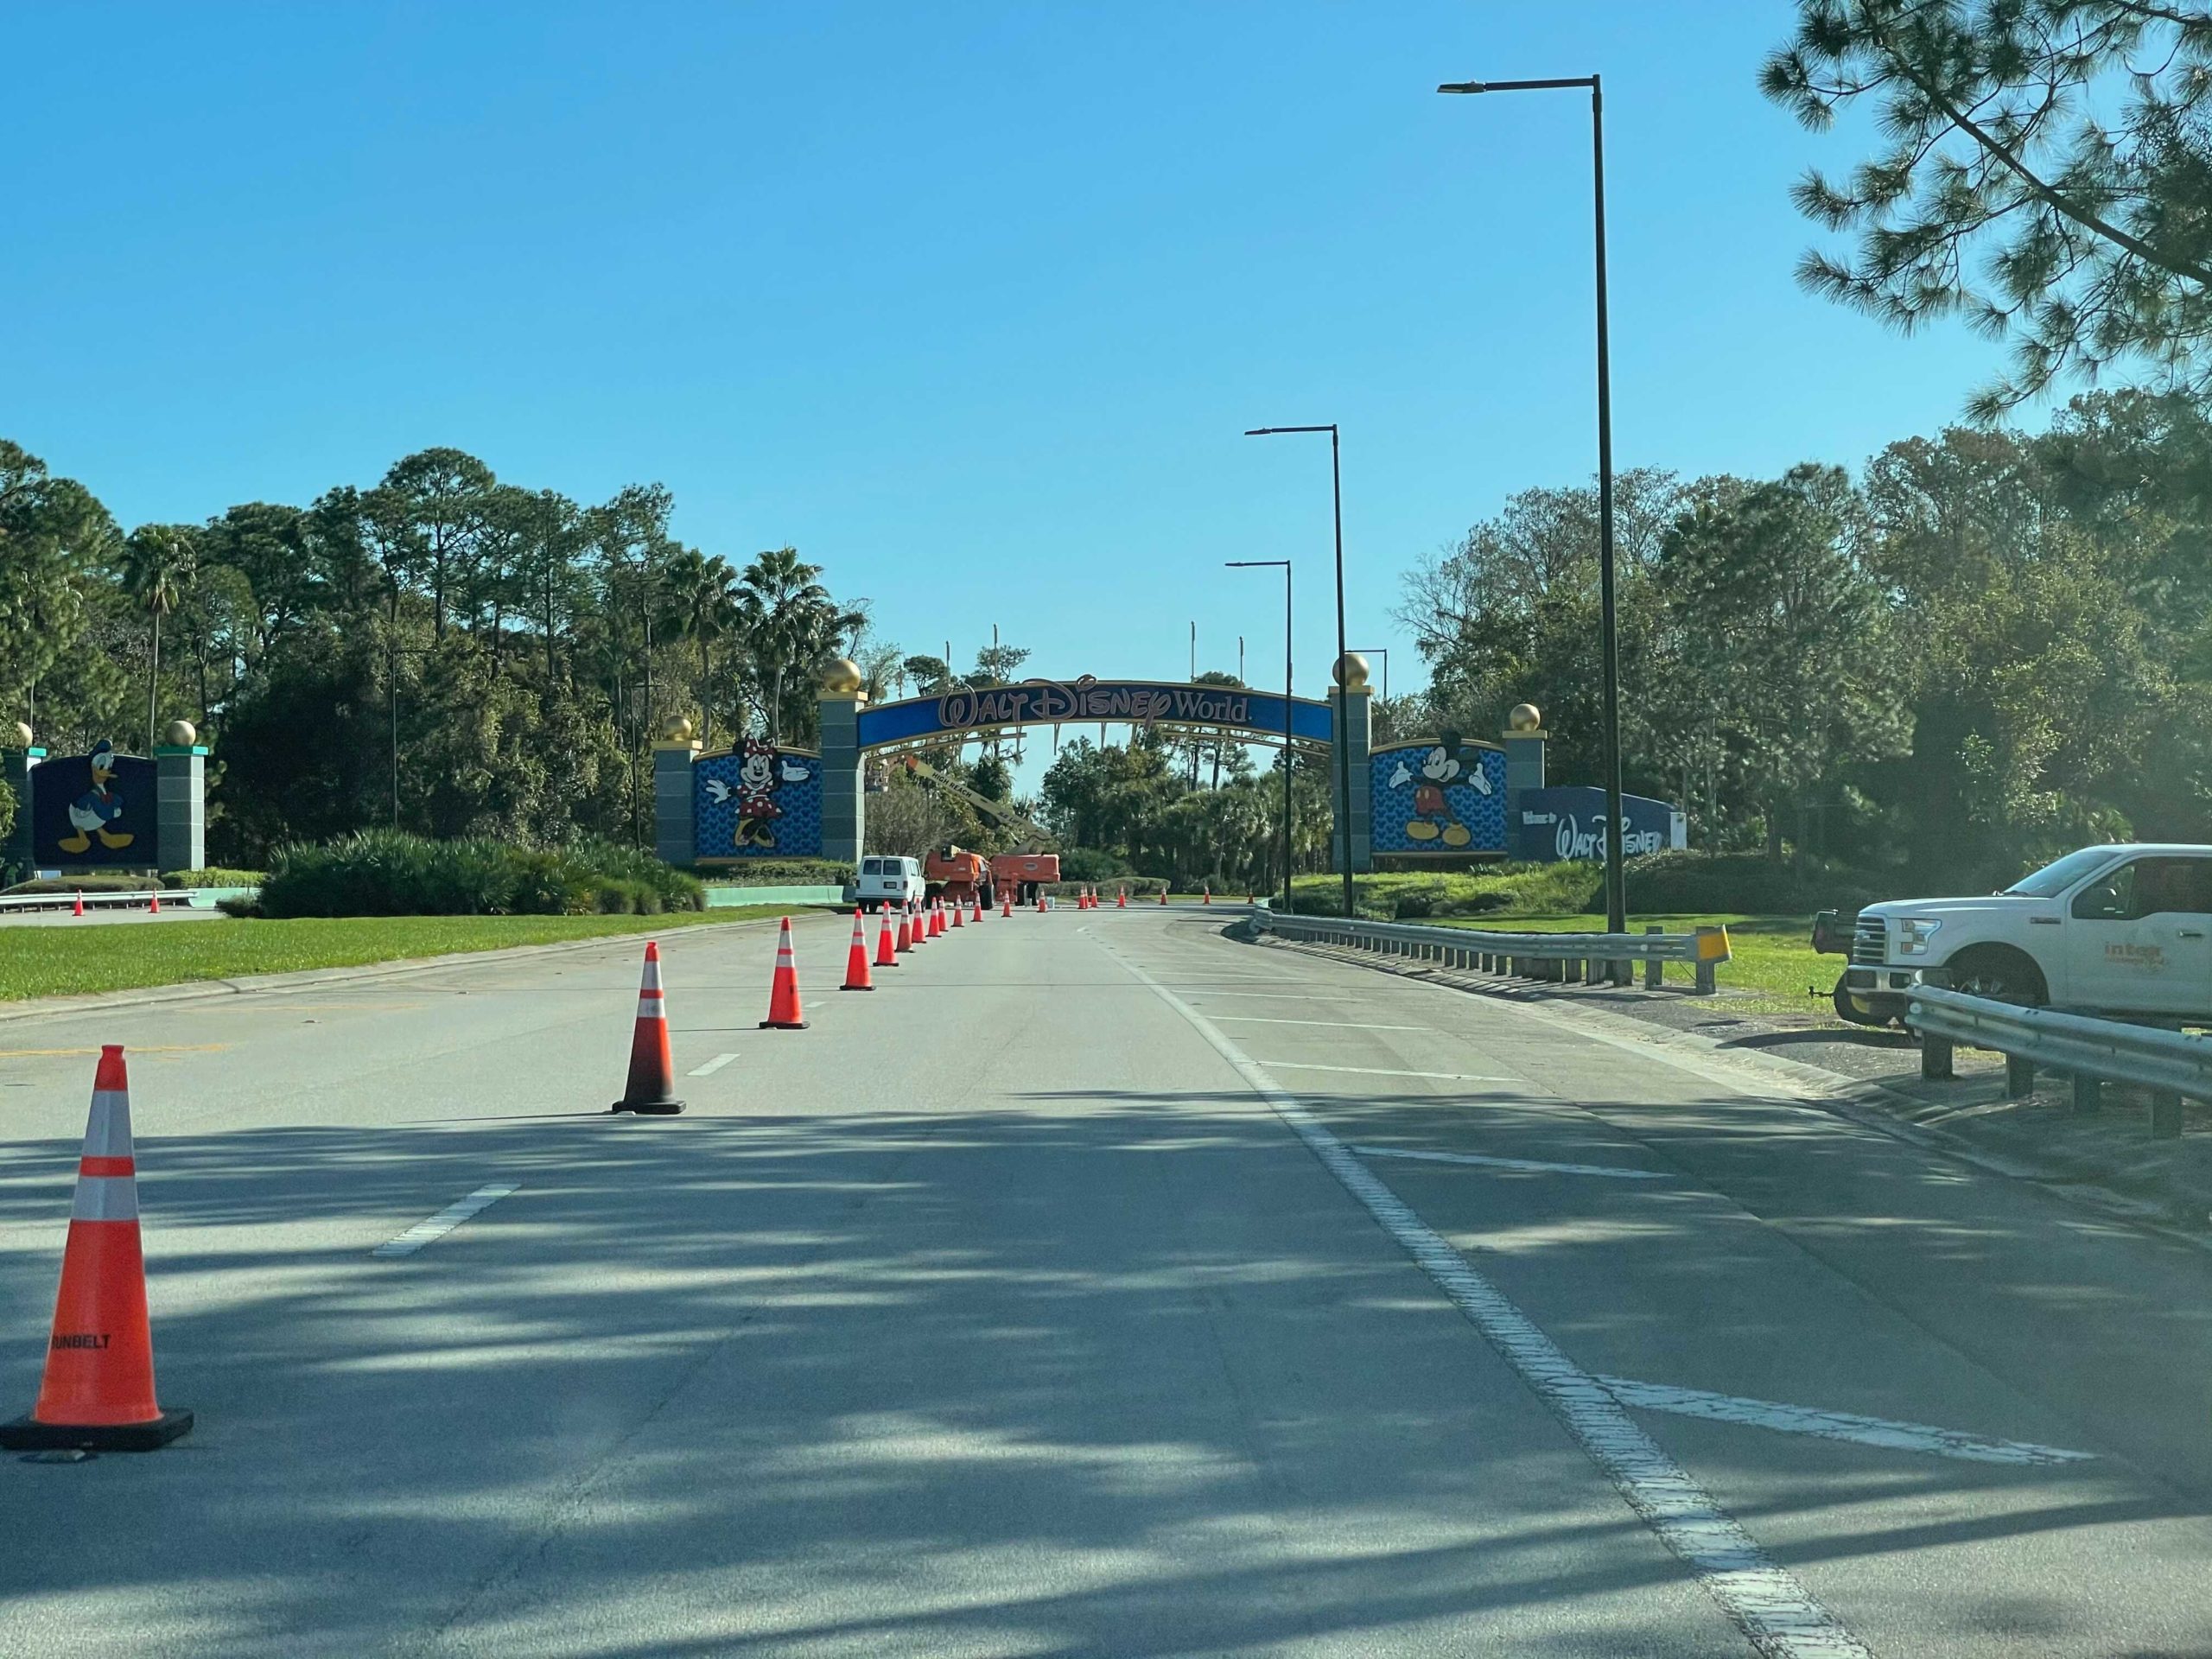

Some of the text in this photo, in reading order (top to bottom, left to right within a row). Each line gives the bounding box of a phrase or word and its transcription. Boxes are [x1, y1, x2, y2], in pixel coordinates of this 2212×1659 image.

[938, 682, 1028, 729] WALT
[1022, 674, 1172, 734] DISNEY
[931, 772, 973, 798] HIGH REACH
